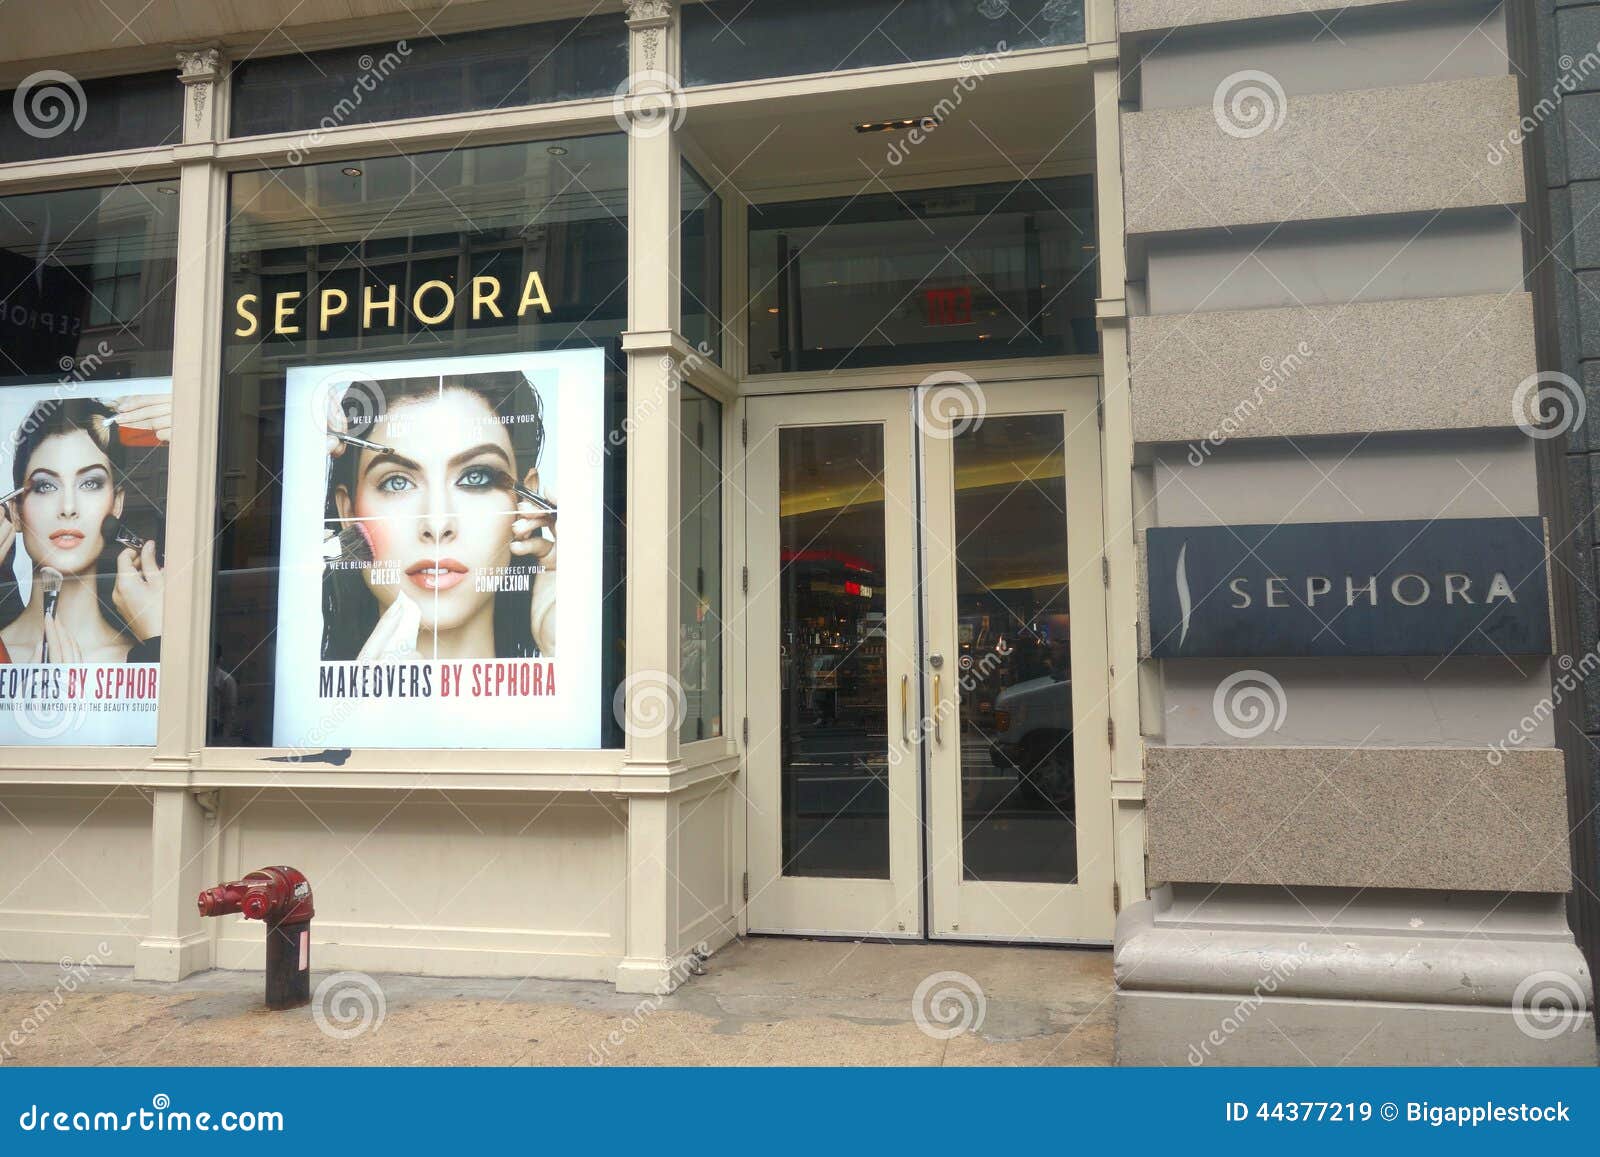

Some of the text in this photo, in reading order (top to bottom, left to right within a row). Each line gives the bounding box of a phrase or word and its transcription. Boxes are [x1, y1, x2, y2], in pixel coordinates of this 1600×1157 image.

[234, 271, 552, 337] SEPHORA
[517, 414, 535, 424] YOUR
[329, 561, 349, 570] WE'LL
[350, 561, 372, 570] BLUSH
[475, 565, 546, 576] LET'S PERFECT YOUR
[475, 575, 530, 592] COMPLEXION
[1229, 571, 1517, 609] SEPHORA
[68, 668, 88, 699] BY
[95, 667, 157, 699] SEPHOR
[319, 662, 556, 698] MAKEOVERS BY SEPHORA
[41, 702, 77, 712] MAKEOVER
[89, 702, 101, 712] THE
[104, 702, 129, 712] BEAUTY
